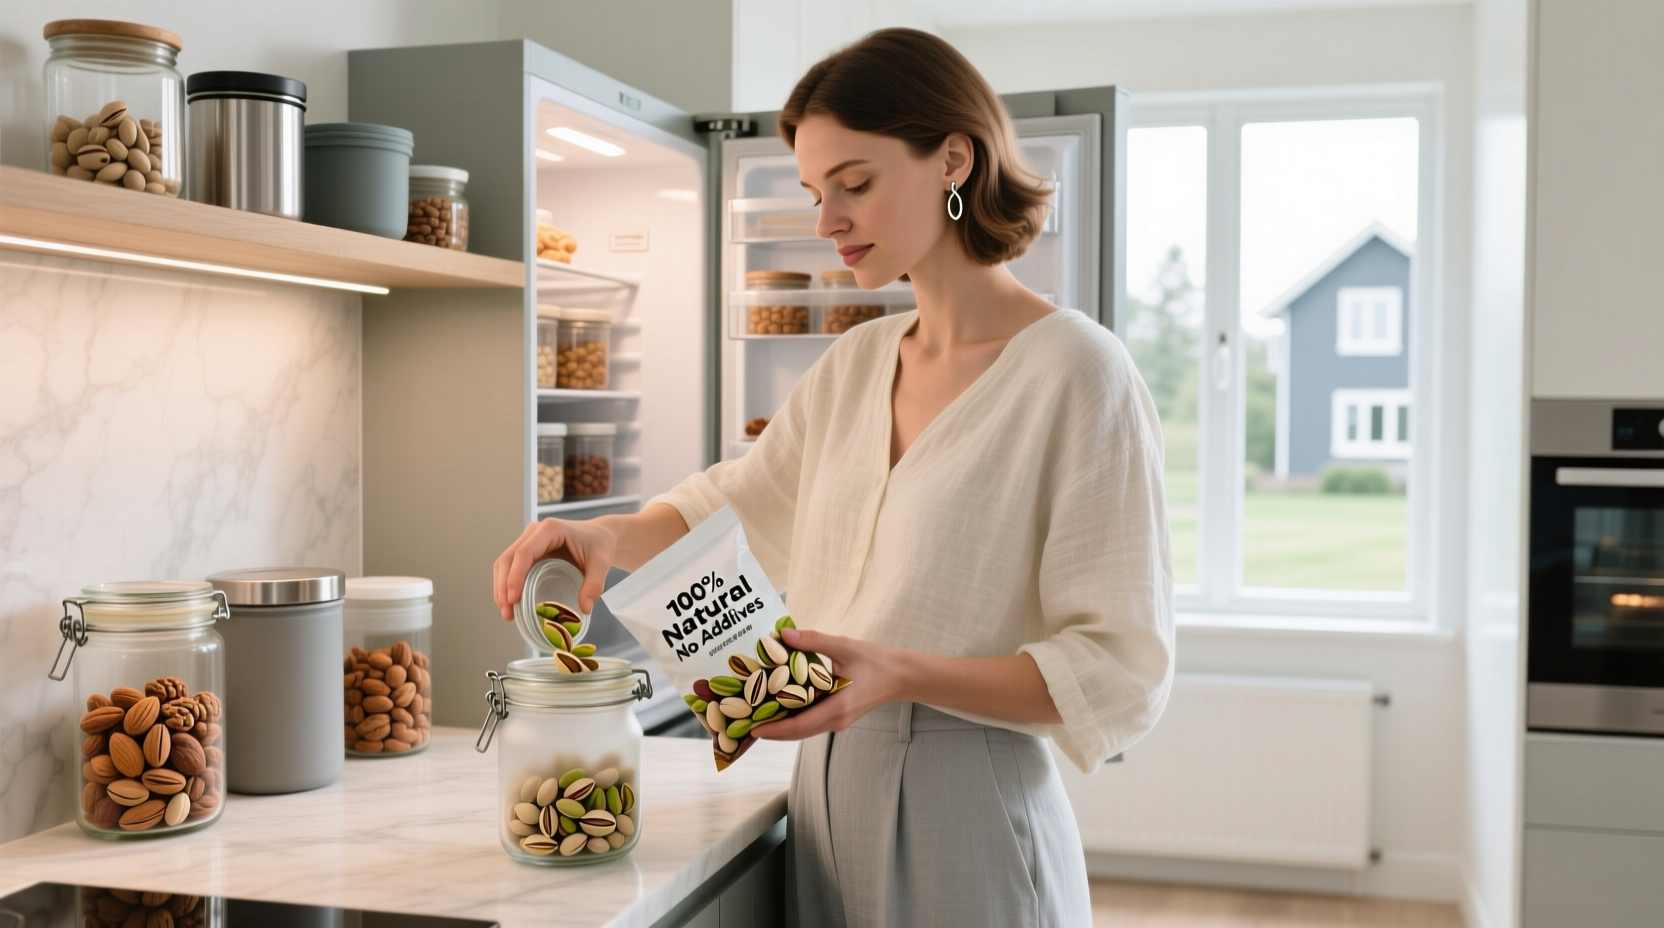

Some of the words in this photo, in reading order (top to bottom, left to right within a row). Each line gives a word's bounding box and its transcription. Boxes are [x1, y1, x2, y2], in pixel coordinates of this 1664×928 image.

[662, 574, 753, 648] Natural
[666, 571, 724, 617] 100%
[676, 642, 699, 663] No
